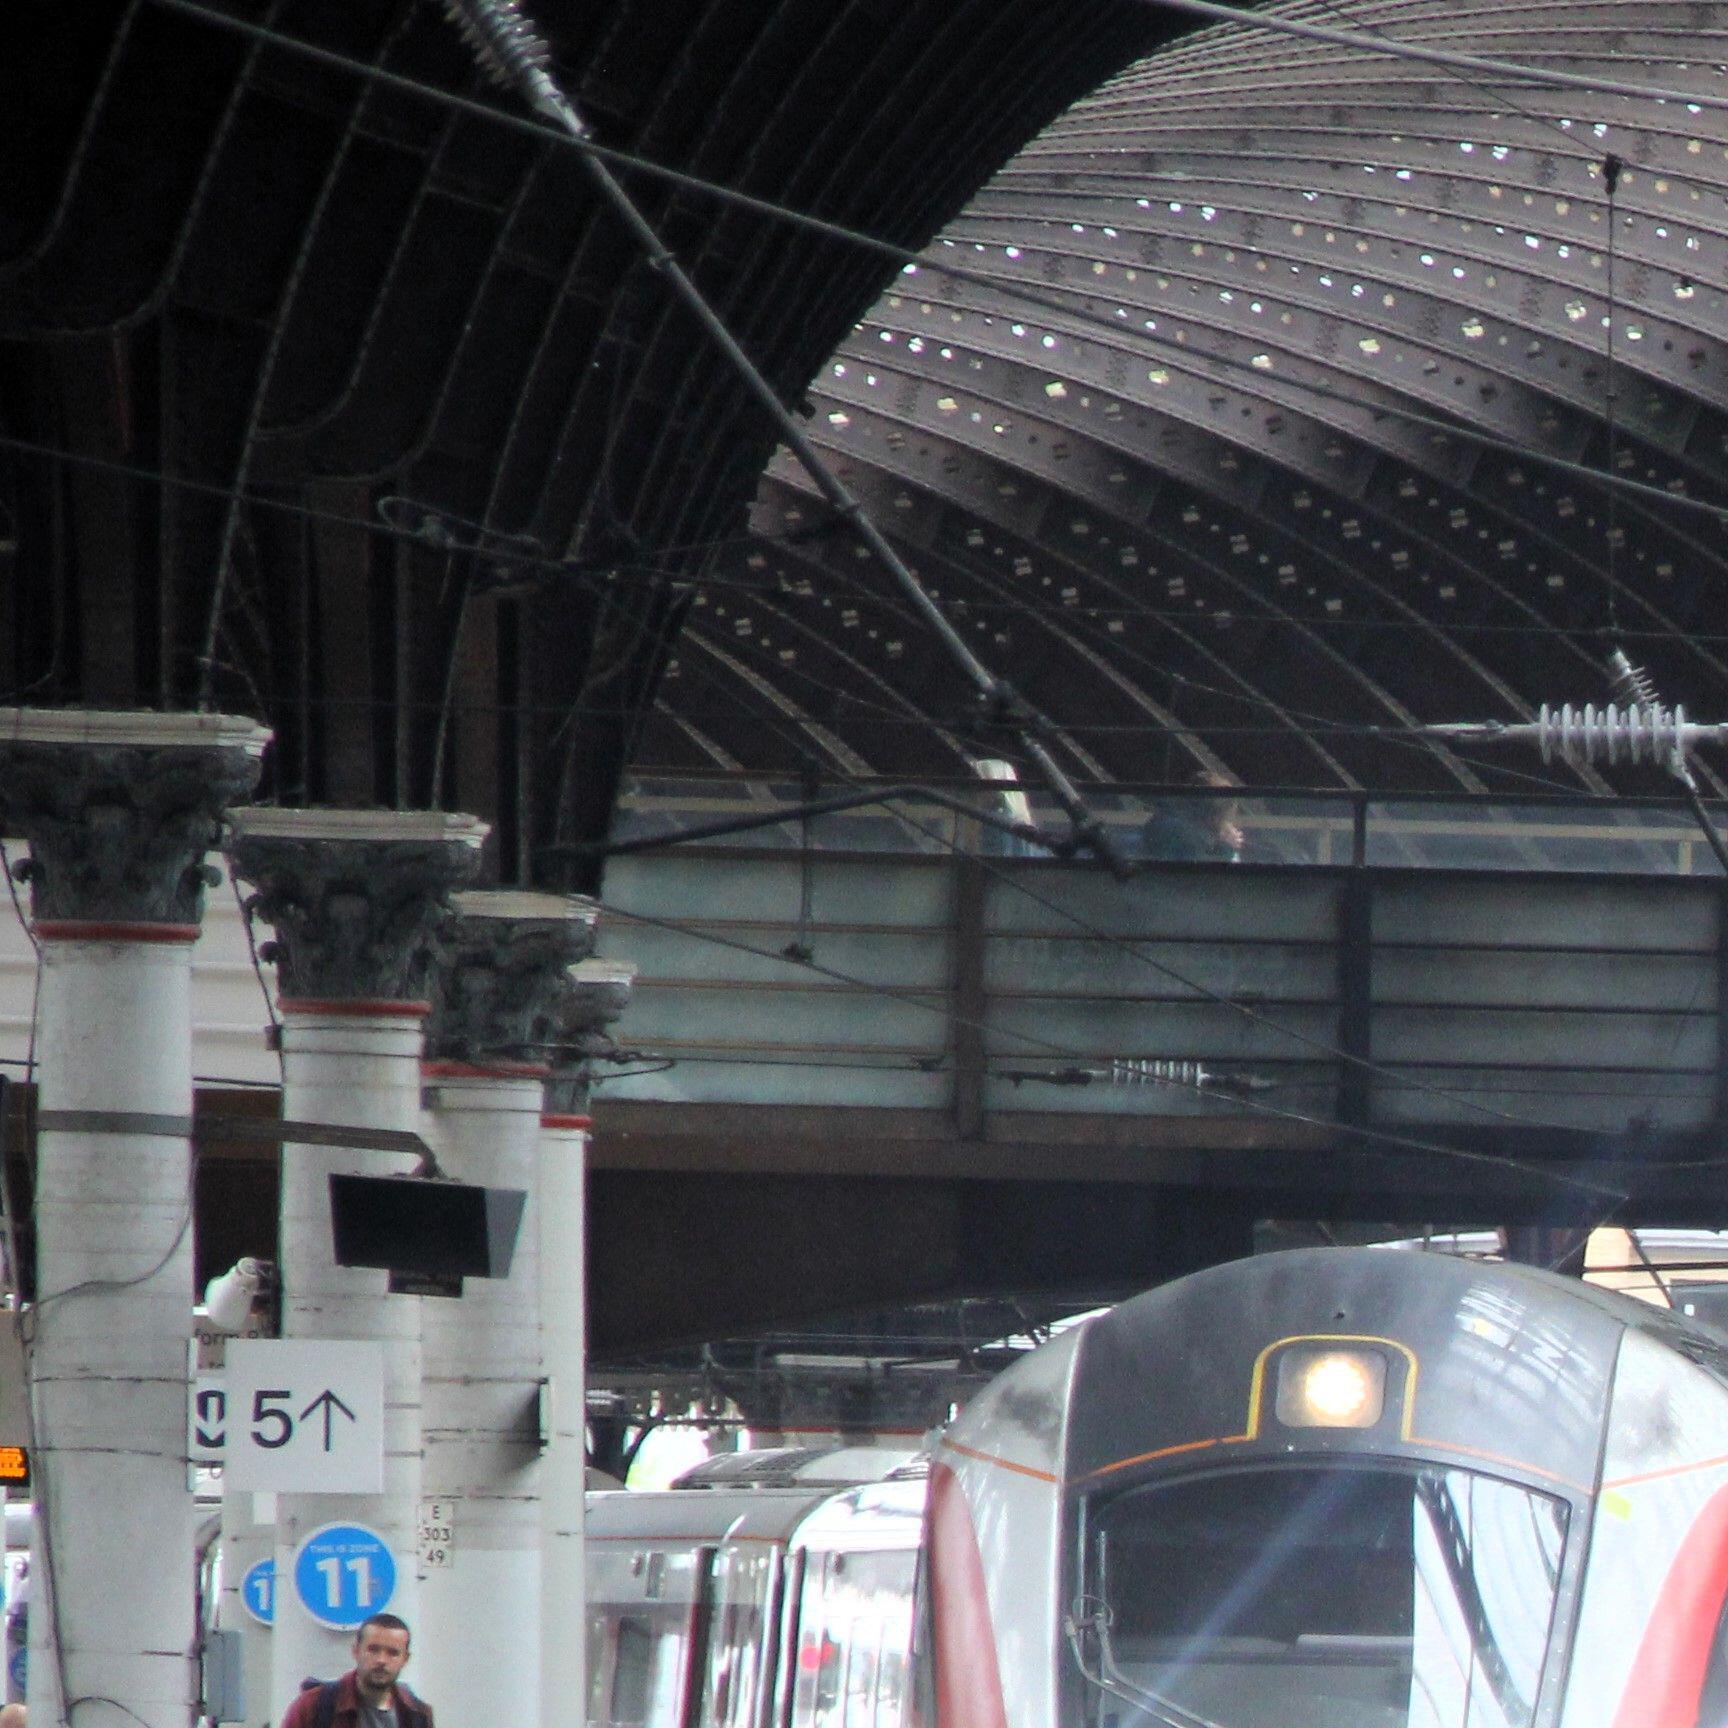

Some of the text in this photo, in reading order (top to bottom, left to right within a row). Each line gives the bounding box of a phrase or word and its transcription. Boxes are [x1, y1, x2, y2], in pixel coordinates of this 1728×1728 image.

[251, 1390, 293, 1449] 5
[432, 1505, 440, 1519] E
[424, 1527, 450, 1541] 303
[426, 1550, 445, 1563] 49
[316, 1557, 372, 1608] 11
